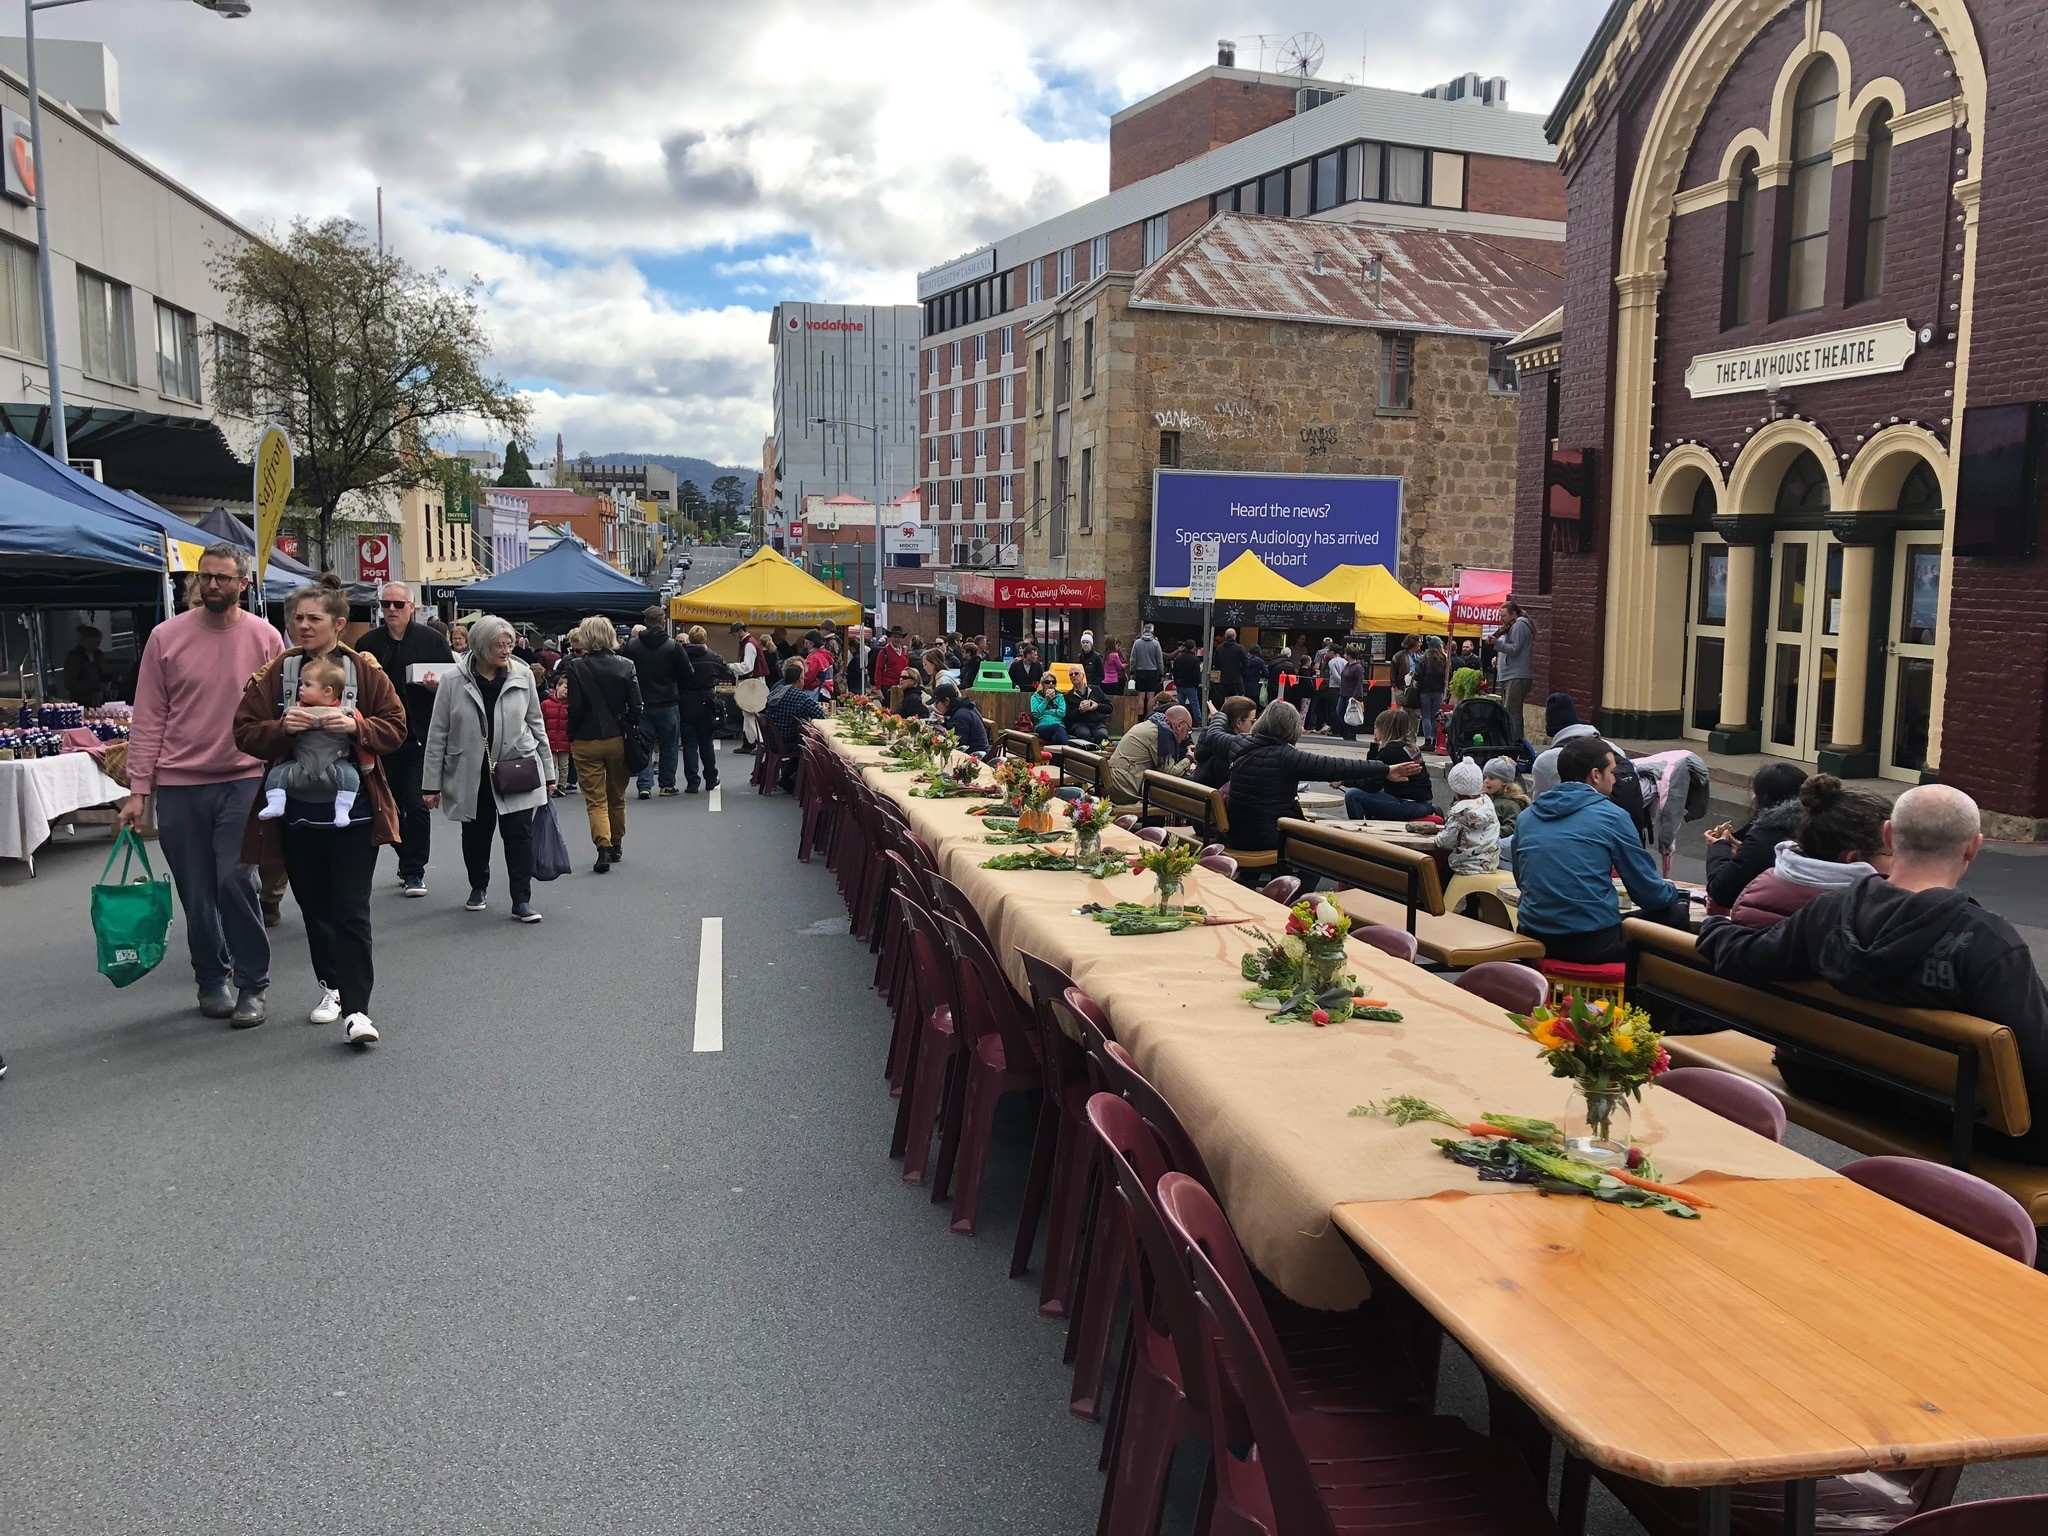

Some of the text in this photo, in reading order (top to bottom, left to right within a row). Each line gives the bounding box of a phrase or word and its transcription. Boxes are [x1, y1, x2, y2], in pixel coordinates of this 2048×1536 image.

[806, 319, 864, 331] vodafone
[1716, 339, 1876, 385] THE PLAYHOUSE THEATRE
[258, 436, 285, 518] Saffron
[1230, 502, 1331, 518] Heard the news?
[1175, 528, 1380, 548] Specsavers Audiology has arrived
[1264, 551, 1308, 566] Hobart
[362, 569, 388, 577] POST
[1193, 565, 1204, 575] 1P
[1015, 584, 1082, 600] The Sewing Room
